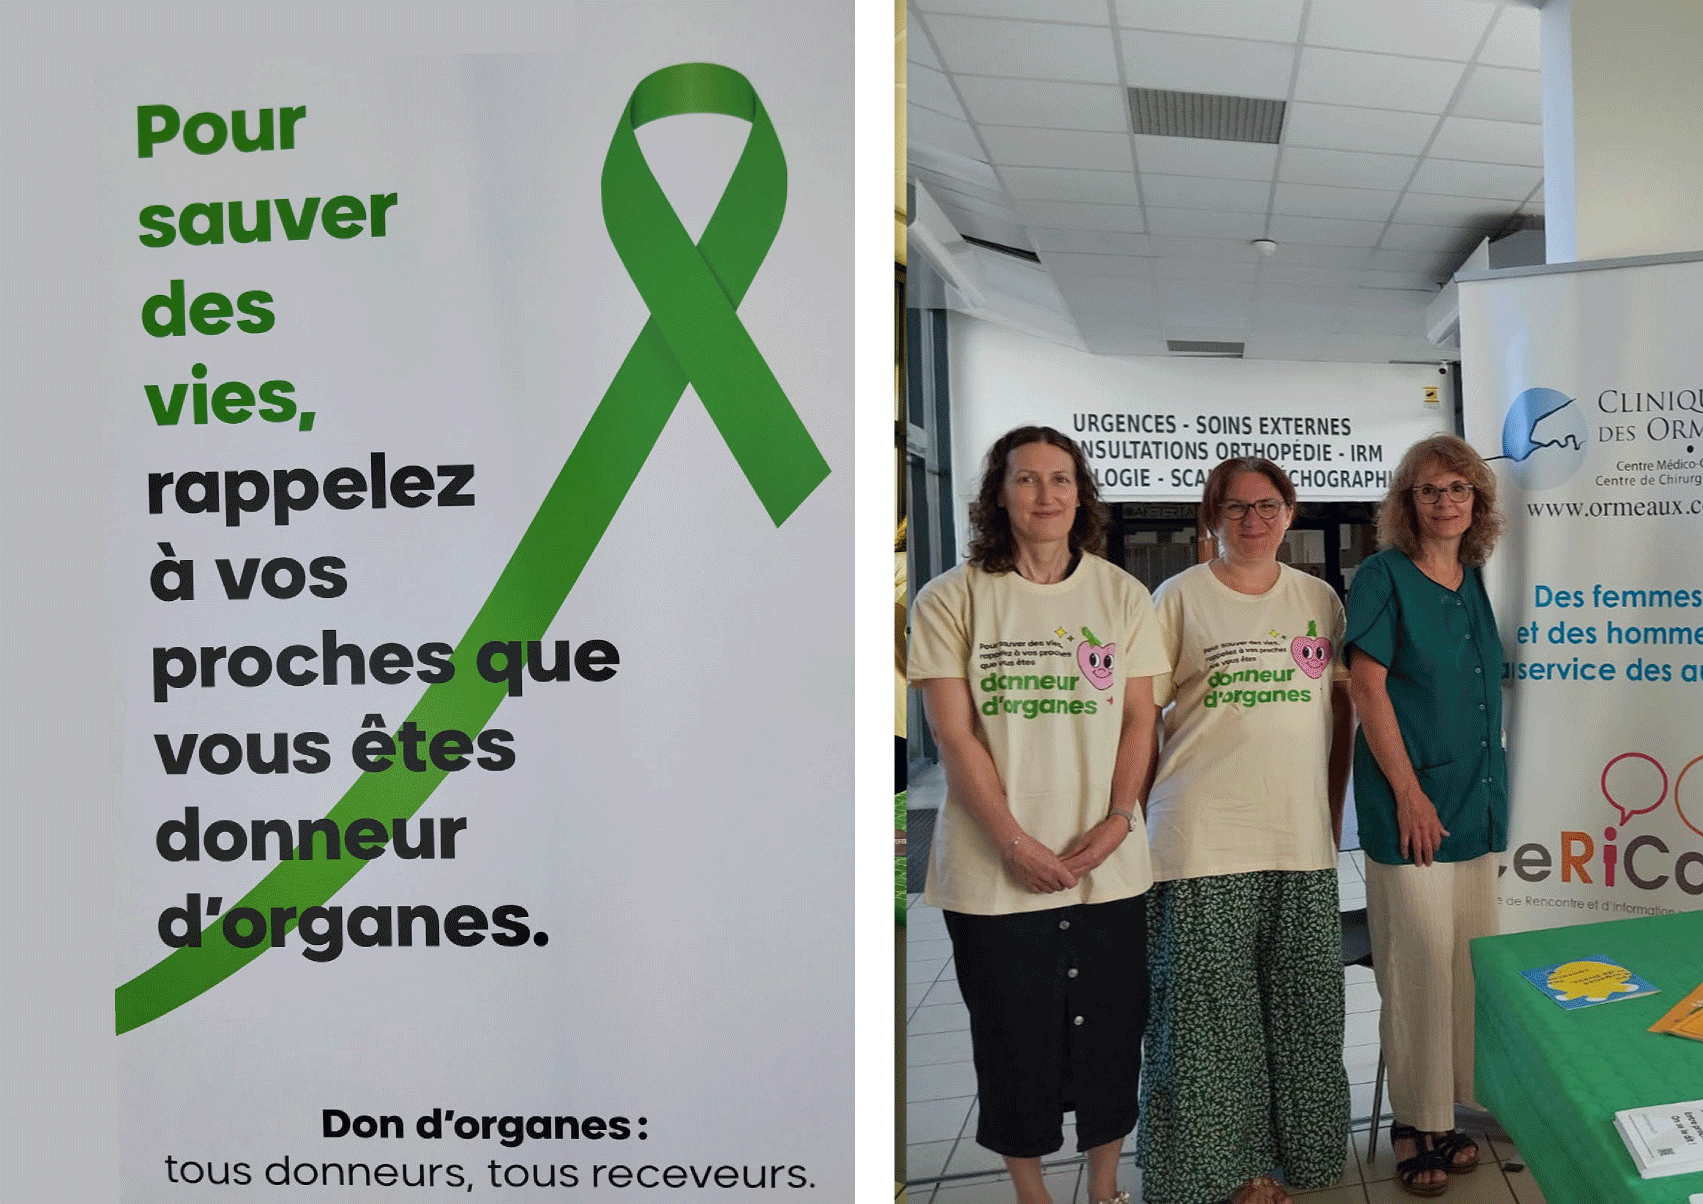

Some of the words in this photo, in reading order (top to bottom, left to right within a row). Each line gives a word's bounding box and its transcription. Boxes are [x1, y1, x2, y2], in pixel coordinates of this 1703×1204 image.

[137, 104, 307, 159] Pour
[138, 192, 398, 248] sauver
[141, 279, 275, 338] des
[144, 362, 316, 432] vies,
[1073, 413, 1176, 435] URGENCES
[1196, 415, 1252, 436] SOINS
[1259, 416, 1351, 437] EXTERNES
[1080, 440, 1209, 461] NSULTATIONS
[1215, 438, 1333, 462] ORTHOPÉDIE
[1351, 444, 1383, 463] IRM
[1616, 459, 1655, 472] Centre
[148, 451, 475, 527] rappelez
[1595, 475, 1636, 487] Centre
[1640, 475, 1655, 487] de
[150, 541, 194, 602] à
[215, 556, 348, 600] vos
[1535, 585, 1585, 608] Des
[1592, 584, 1703, 608] femmes
[1028, 639, 1045, 647] des
[1517, 621, 1539, 644] et
[1548, 620, 1597, 645] des
[152, 629, 456, 703] proches
[476, 639, 620, 697] que
[980, 660, 998, 670] que
[1207, 668, 1295, 688] donneur
[1518, 657, 1616, 681] service
[1625, 658, 1672, 683] des
[981, 695, 1098, 720] d'organes
[1203, 689, 1312, 708] d'organes
[154, 731, 331, 775] vous
[351, 713, 516, 773] êtes
[156, 806, 467, 862] donneur
[1525, 895, 1584, 910] Rencontre
[1587, 899, 1599, 911] et
[157, 893, 549, 963] d'organes.
[322, 1108, 404, 1139] Don
[165, 1154, 253, 1188] tous
[264, 1154, 474, 1193] donneurs,
[487, 1157, 580, 1189] tous
[591, 1163, 817, 1190] receveurs.
